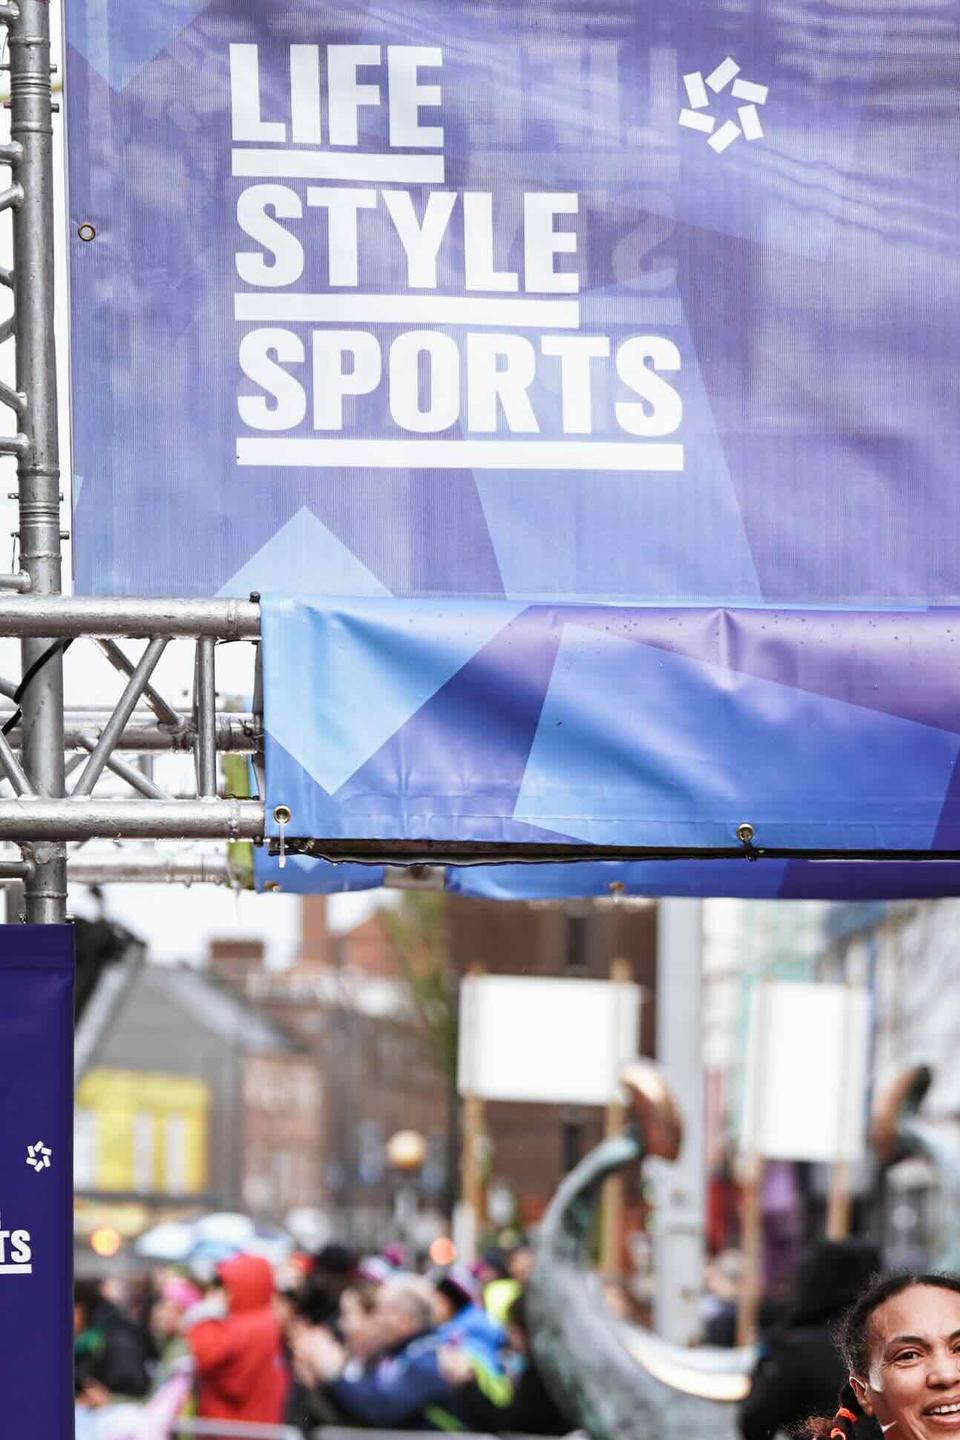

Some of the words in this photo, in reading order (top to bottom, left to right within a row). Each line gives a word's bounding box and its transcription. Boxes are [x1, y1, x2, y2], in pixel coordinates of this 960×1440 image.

[230, 44, 443, 146] LIFE
[236, 186, 579, 293] STYLE
[238, 328, 683, 436] SPORTS
